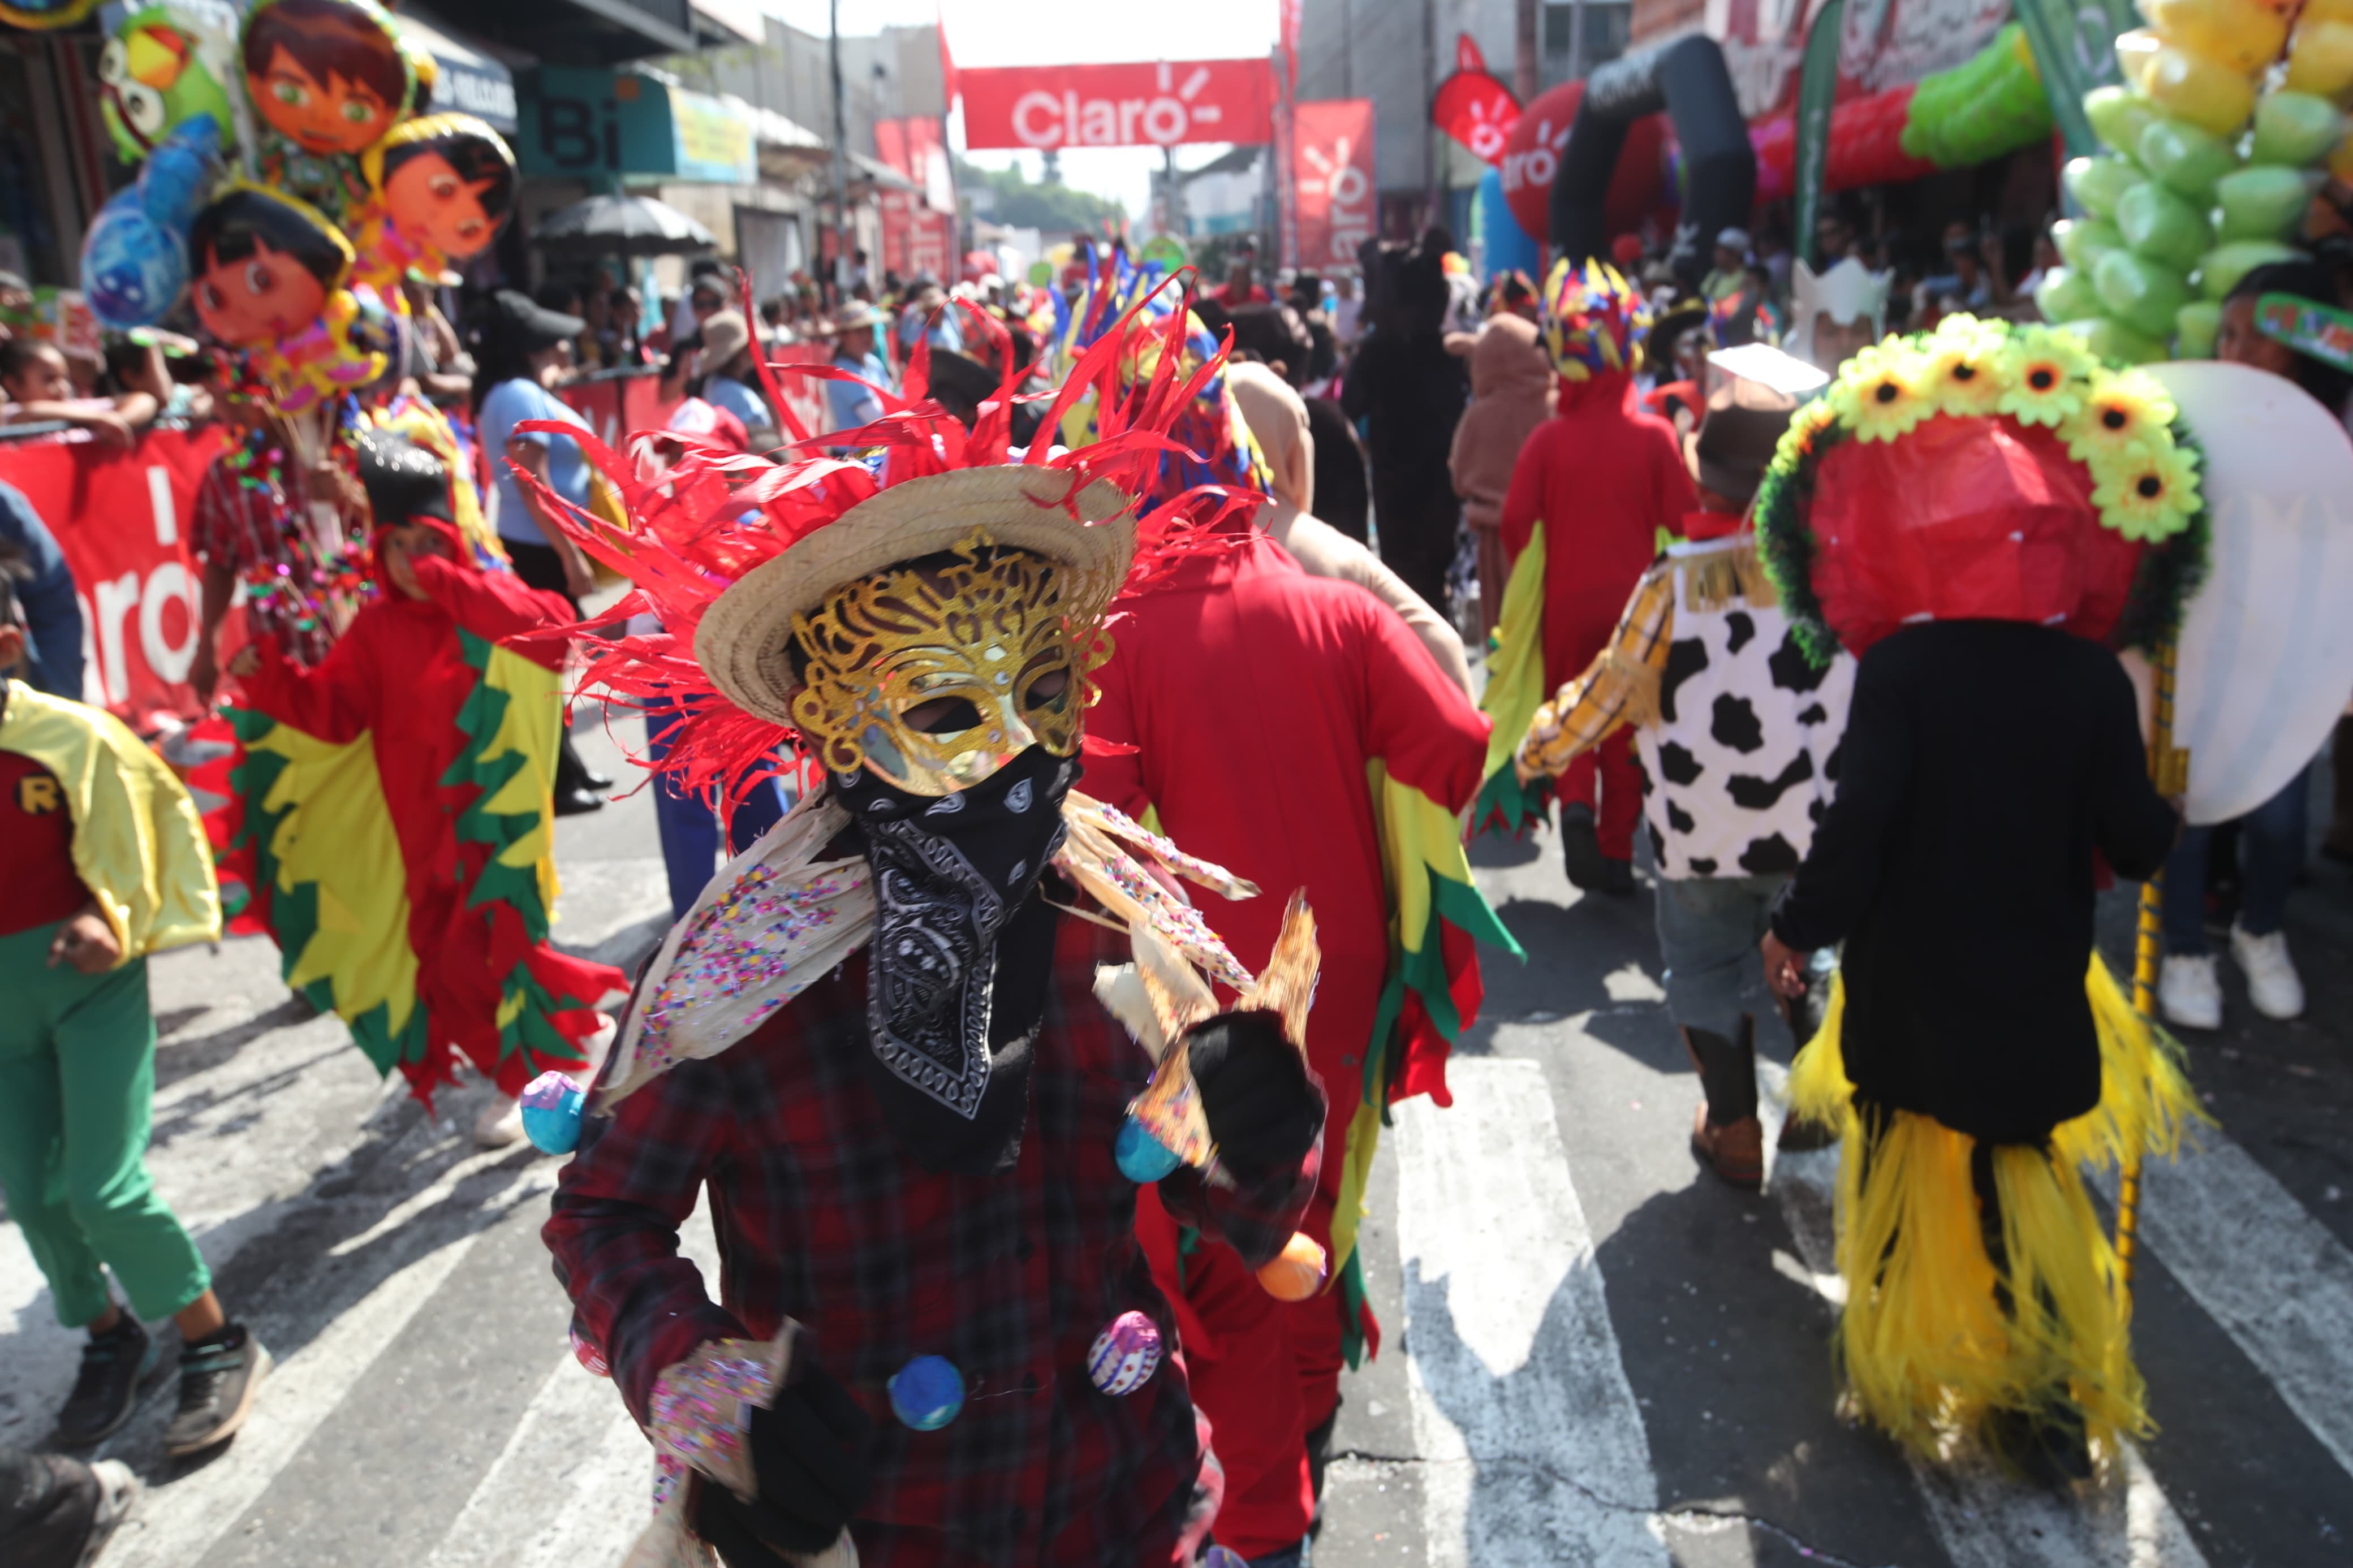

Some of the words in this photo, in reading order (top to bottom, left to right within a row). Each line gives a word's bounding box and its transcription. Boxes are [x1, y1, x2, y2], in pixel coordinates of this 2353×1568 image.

[539, 96, 620, 169] Bi
[1012, 90, 1187, 147] Claro
[21, 776, 57, 813] R
